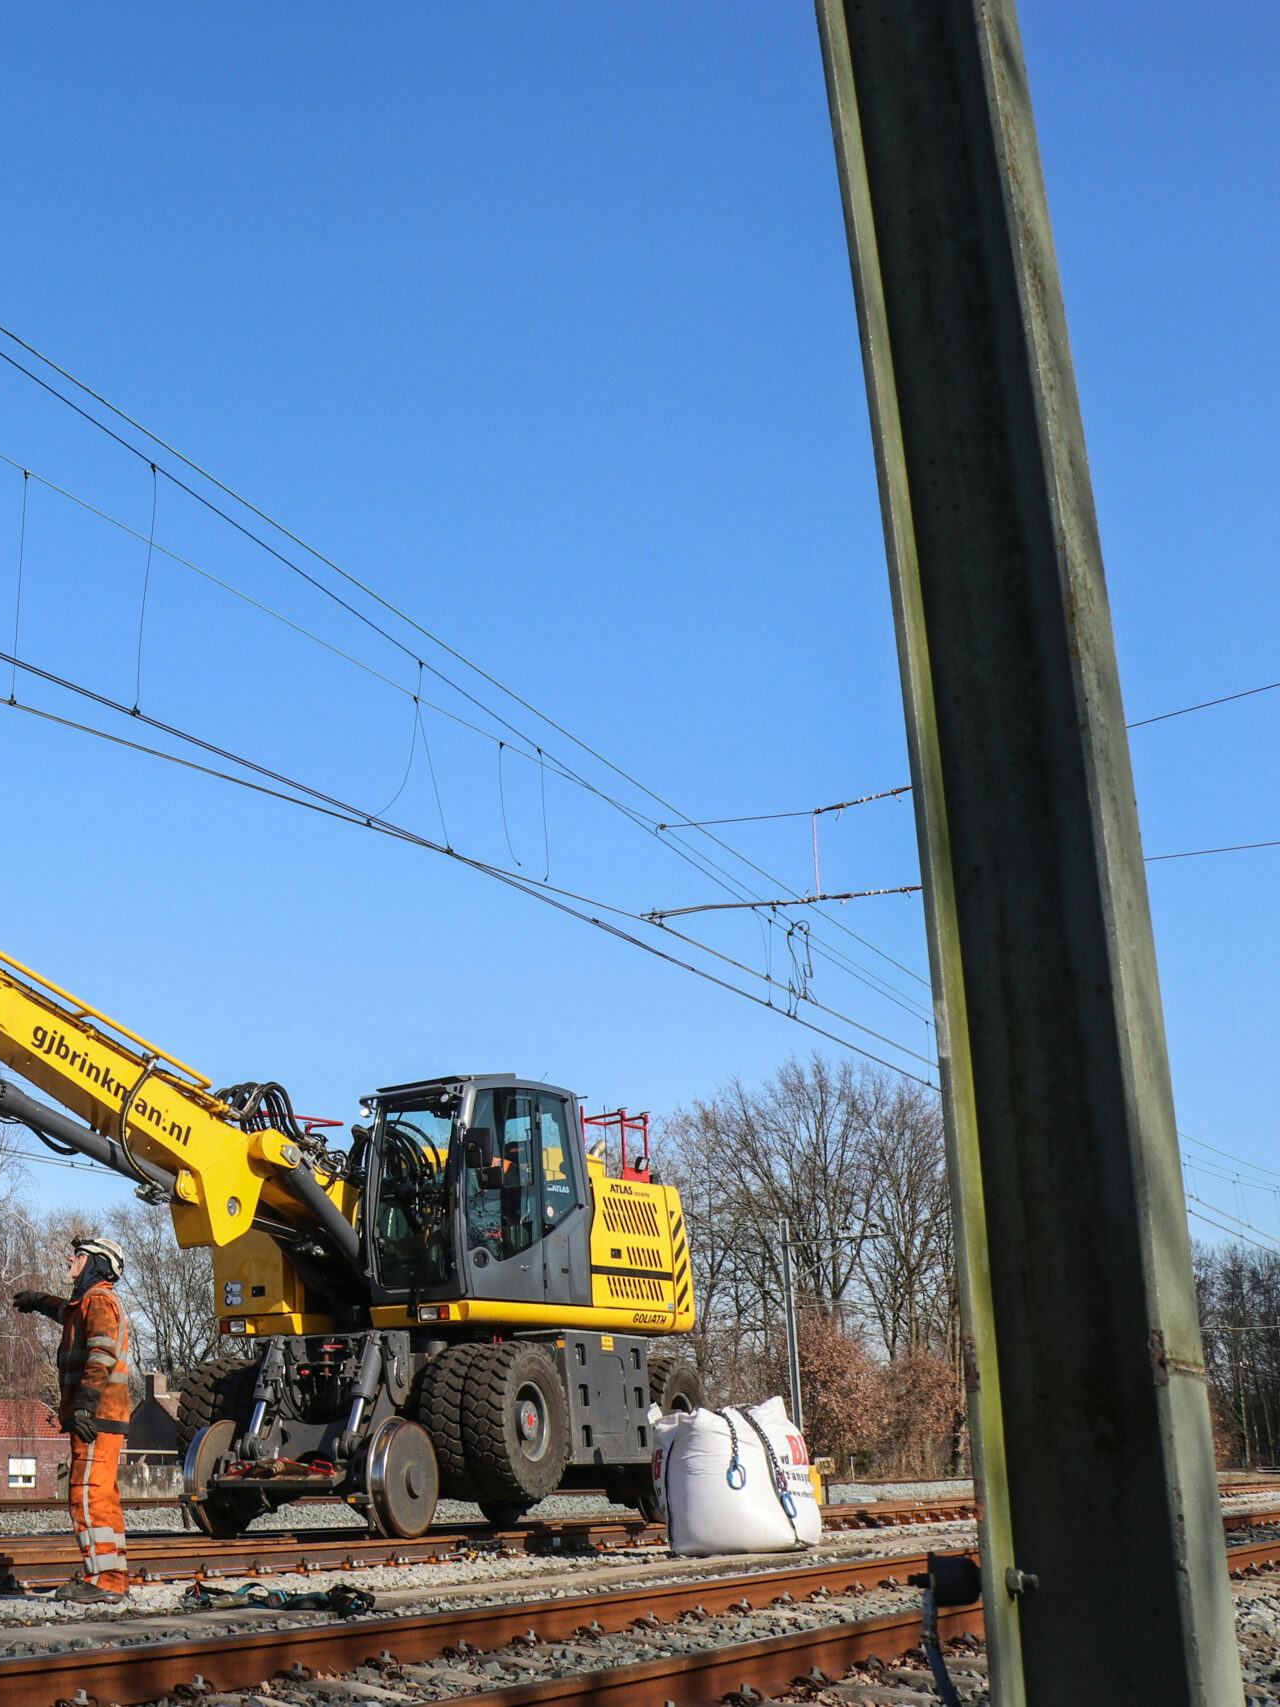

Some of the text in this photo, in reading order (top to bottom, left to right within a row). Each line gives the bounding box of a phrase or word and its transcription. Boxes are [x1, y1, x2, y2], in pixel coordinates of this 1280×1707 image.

[31, 1025, 192, 1147] gjbrinkman.nl
[552, 1184, 570, 1194] ATLAS
[610, 1183, 633, 1195] ATLAS
[632, 1312, 667, 1325] GOLIATH
